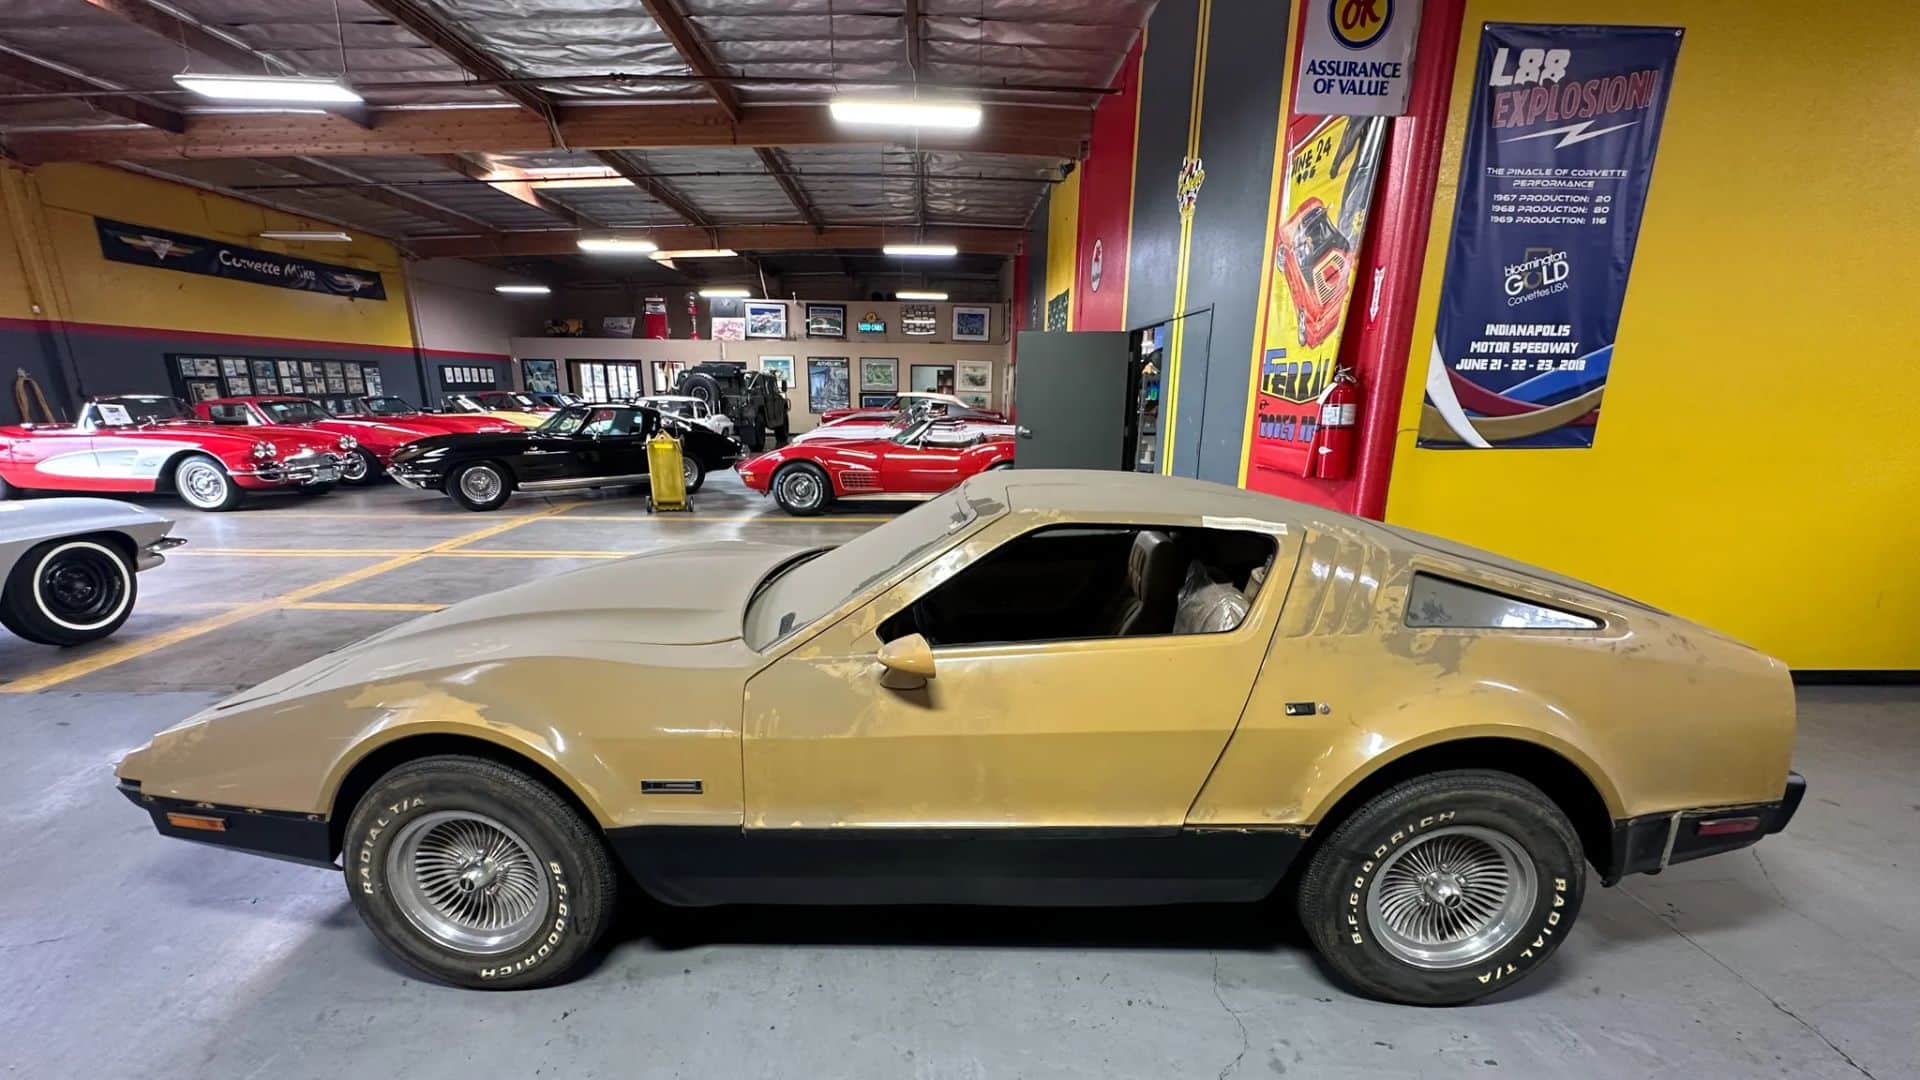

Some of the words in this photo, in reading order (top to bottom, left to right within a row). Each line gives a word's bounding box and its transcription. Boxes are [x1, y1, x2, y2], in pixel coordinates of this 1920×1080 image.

[1341, 0, 1381, 30] OK
[1306, 59, 1402, 78] ASSURANCE
[1490, 48, 1570, 86] L88
[1313, 78, 1335, 94] OF
[1338, 79, 1389, 96] VALUE
[1487, 167, 1505, 175] THE
[1506, 168, 1552, 176] PINACLE
[1554, 169, 1568, 177] OF
[1571, 169, 1628, 177] CORVETTE
[1513, 180, 1595, 188] PERFORMANCE
[1493, 194, 1517, 202] 1967
[1595, 195, 1611, 203] 20
[1517, 205, 1588, 213] PRODUCTION:
[1515, 216, 1586, 224] PRODUCTION:
[219, 250, 281, 275] Corvette
[1504, 251, 1567, 277] bloomington
[1504, 260, 1569, 296] GOLD
[1507, 288, 1550, 306] Corvettes
[1550, 281, 1568, 294] USA
[1485, 324, 1571, 336] INDIANAPOLIS
[1470, 341, 1510, 353] MOTOR
[1512, 342, 1579, 354] SPEEDWAY
[1456, 359, 1488, 370] JUNE
[1489, 359, 1502, 370] 21
[1511, 359, 1527, 370] 22
[1559, 360, 1586, 371] 2018
[360, 815, 390, 895] RADIAL
[390, 797, 425, 815] T/A
[1520, 878, 1567, 959] RADIAL
[1477, 963, 1518, 984] T/A
